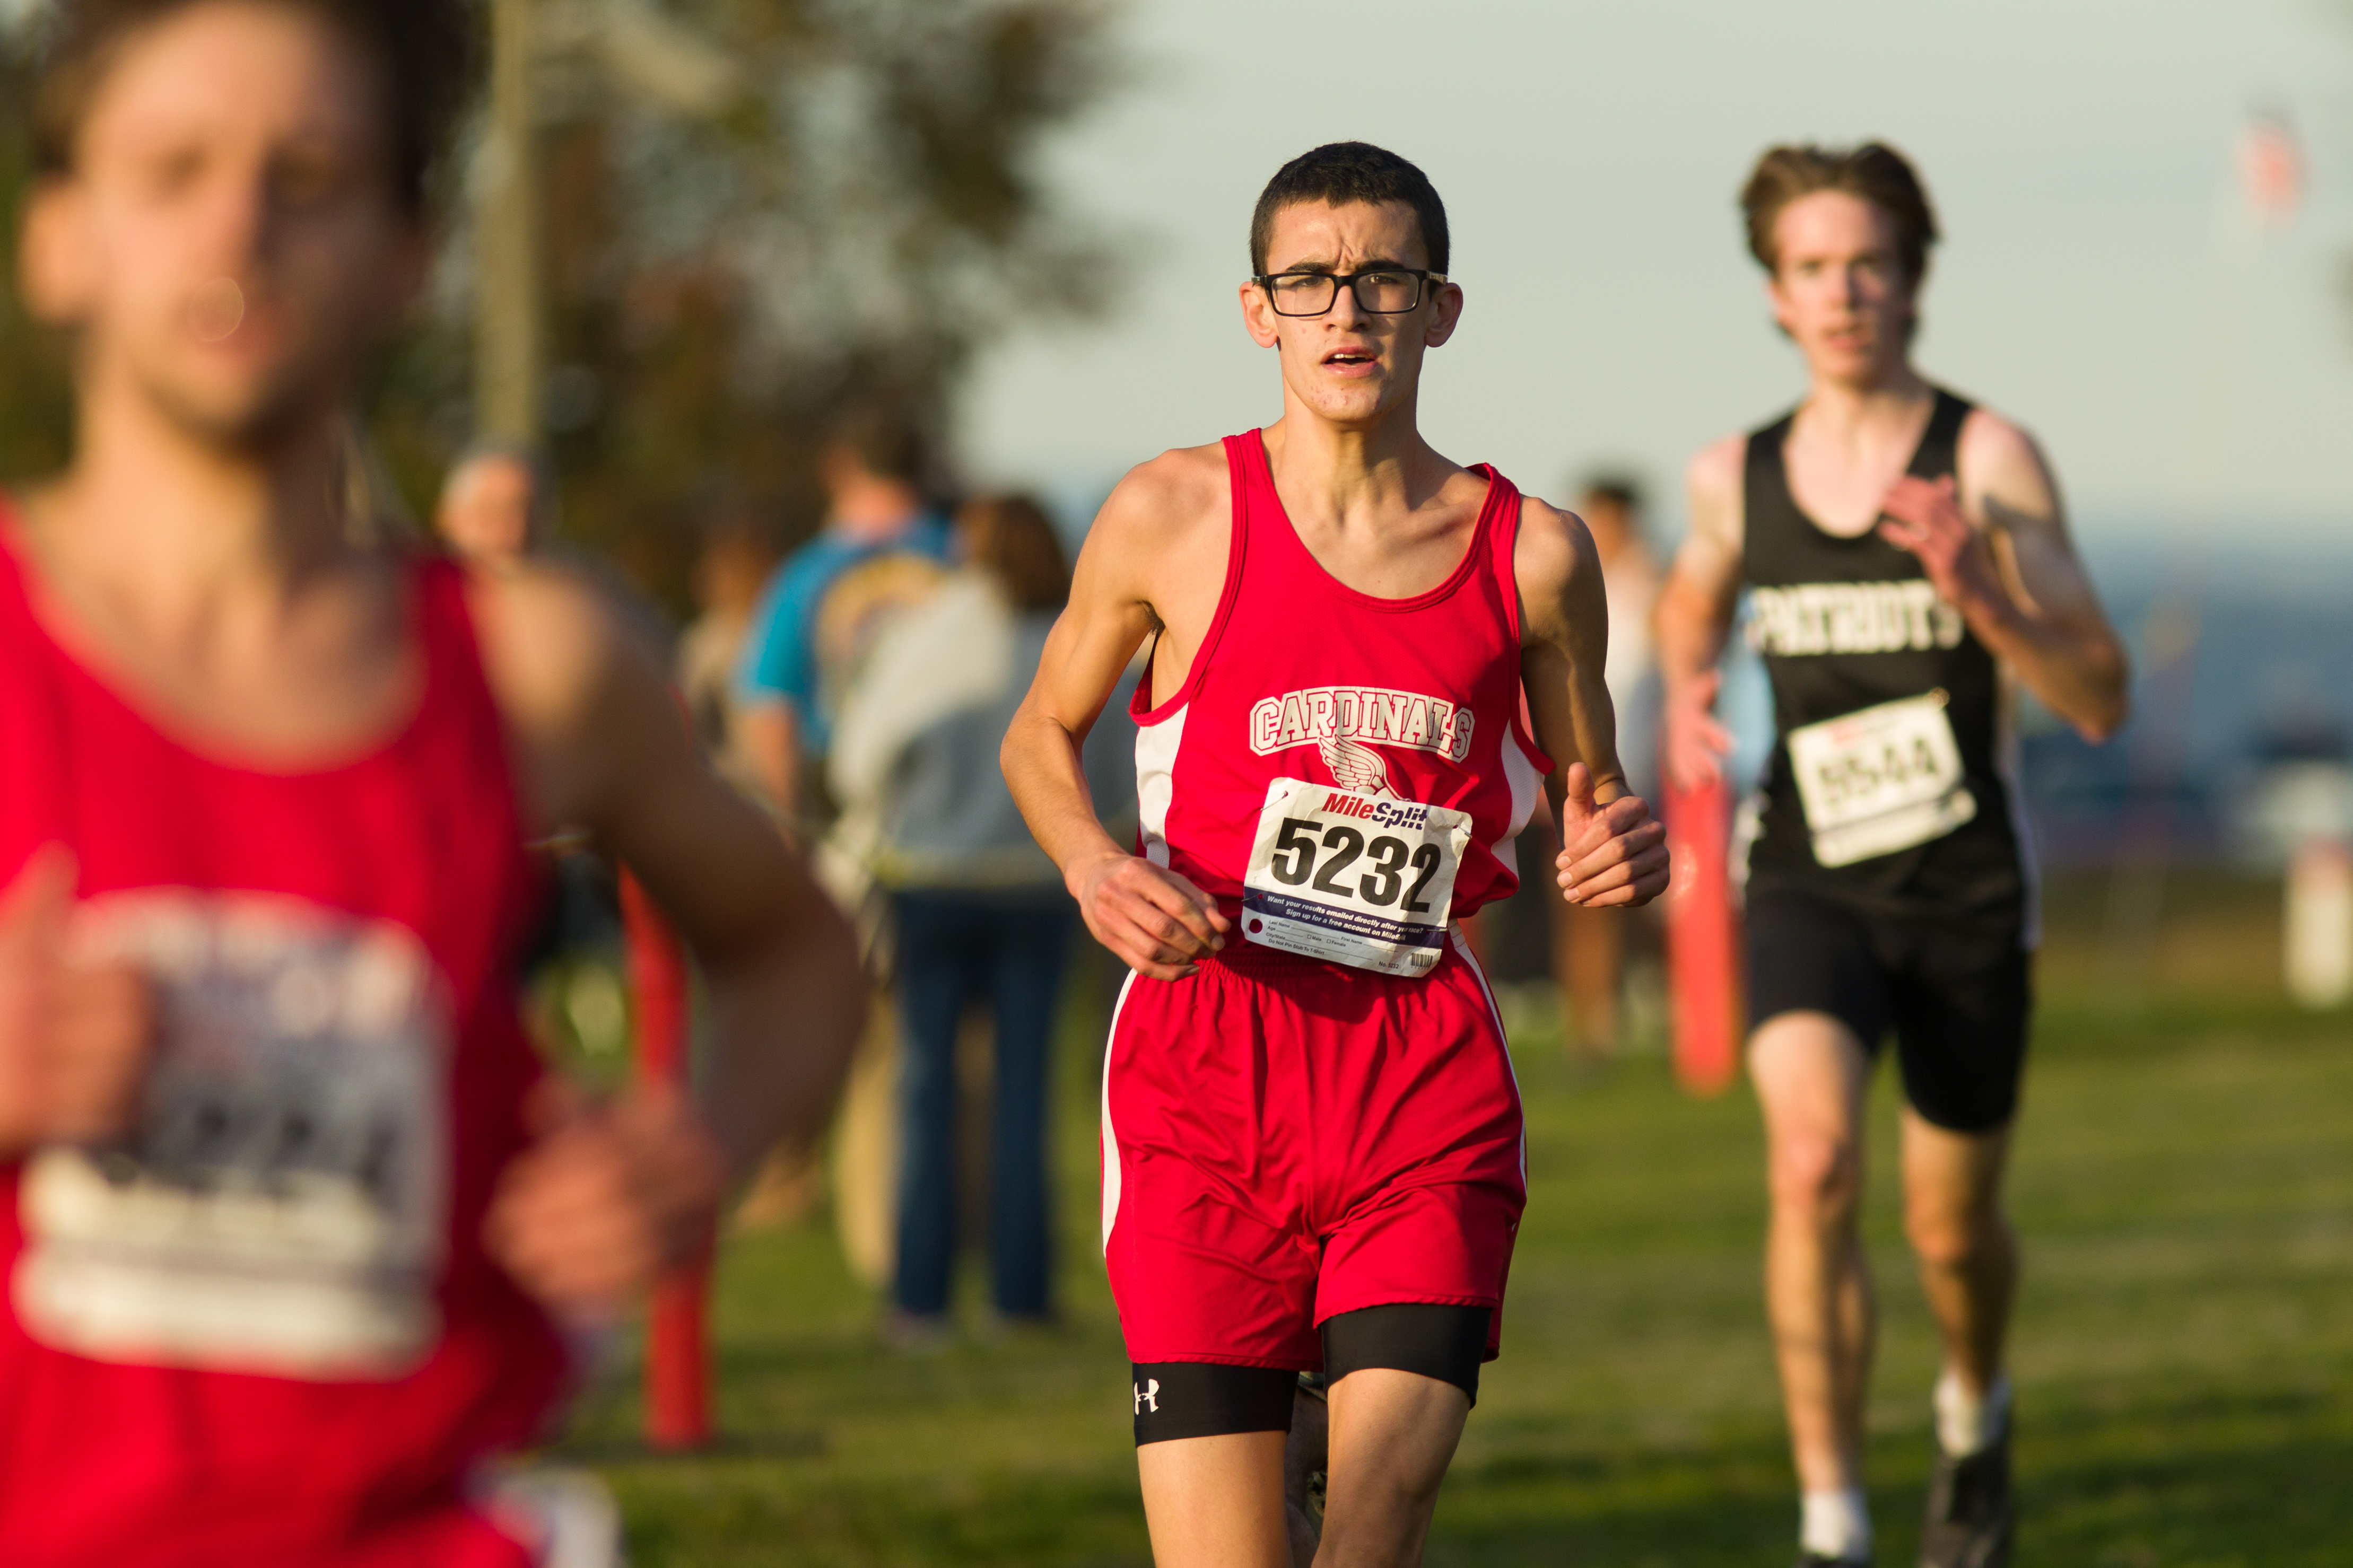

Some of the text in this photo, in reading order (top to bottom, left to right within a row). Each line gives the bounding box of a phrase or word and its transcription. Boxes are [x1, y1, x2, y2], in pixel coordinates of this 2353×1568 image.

[1249, 686, 1476, 764] CARDINALS
[1321, 793, 1428, 830] MileSplit
[1271, 817, 1441, 913] 5232
[1267, 895, 1285, 904] Want
[1302, 904, 1326, 914] results
[1326, 909, 1354, 921] emailed
[1354, 916, 1380, 927] directly
[1381, 922, 1397, 931] after
[1286, 908, 1301, 917] Sign
[1329, 918, 1343, 927] free
[1343, 923, 1371, 934] account
